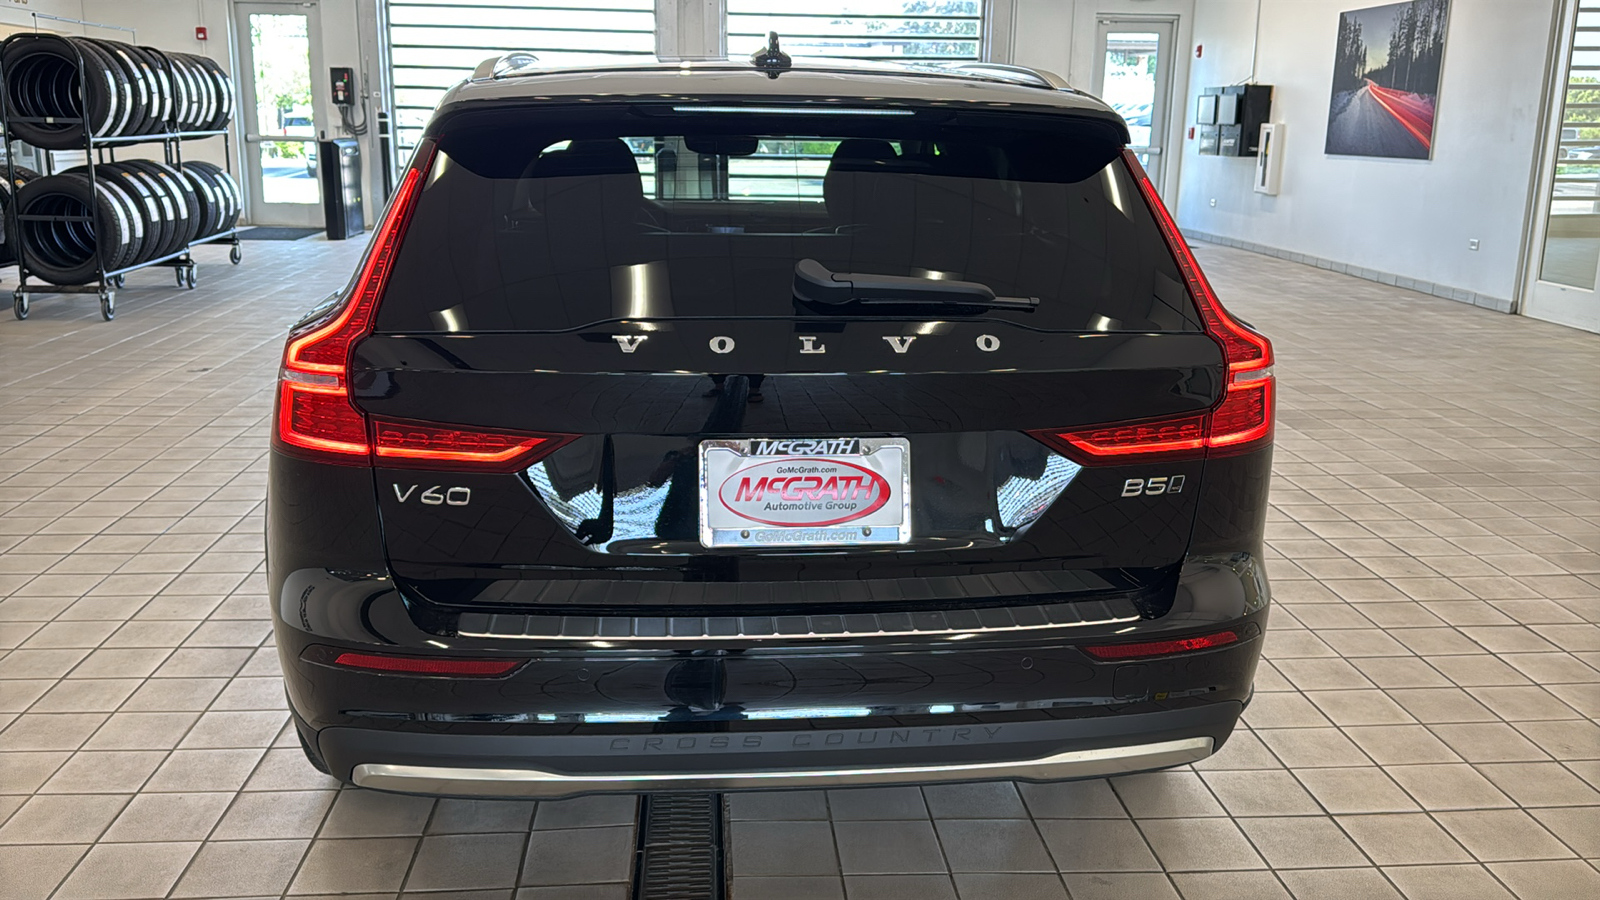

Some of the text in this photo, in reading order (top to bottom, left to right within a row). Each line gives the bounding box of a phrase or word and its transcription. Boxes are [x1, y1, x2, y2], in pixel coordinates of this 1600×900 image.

[612, 334, 1001, 354] VOLVO
[776, 466, 838, 474] GoMcGrath.com
[392, 483, 471, 506] V60
[763, 500, 857, 511] Automotive Group
[755, 529, 858, 543] GoMcGrath.com
[609, 725, 1003, 751] CROSS COUNTRY
